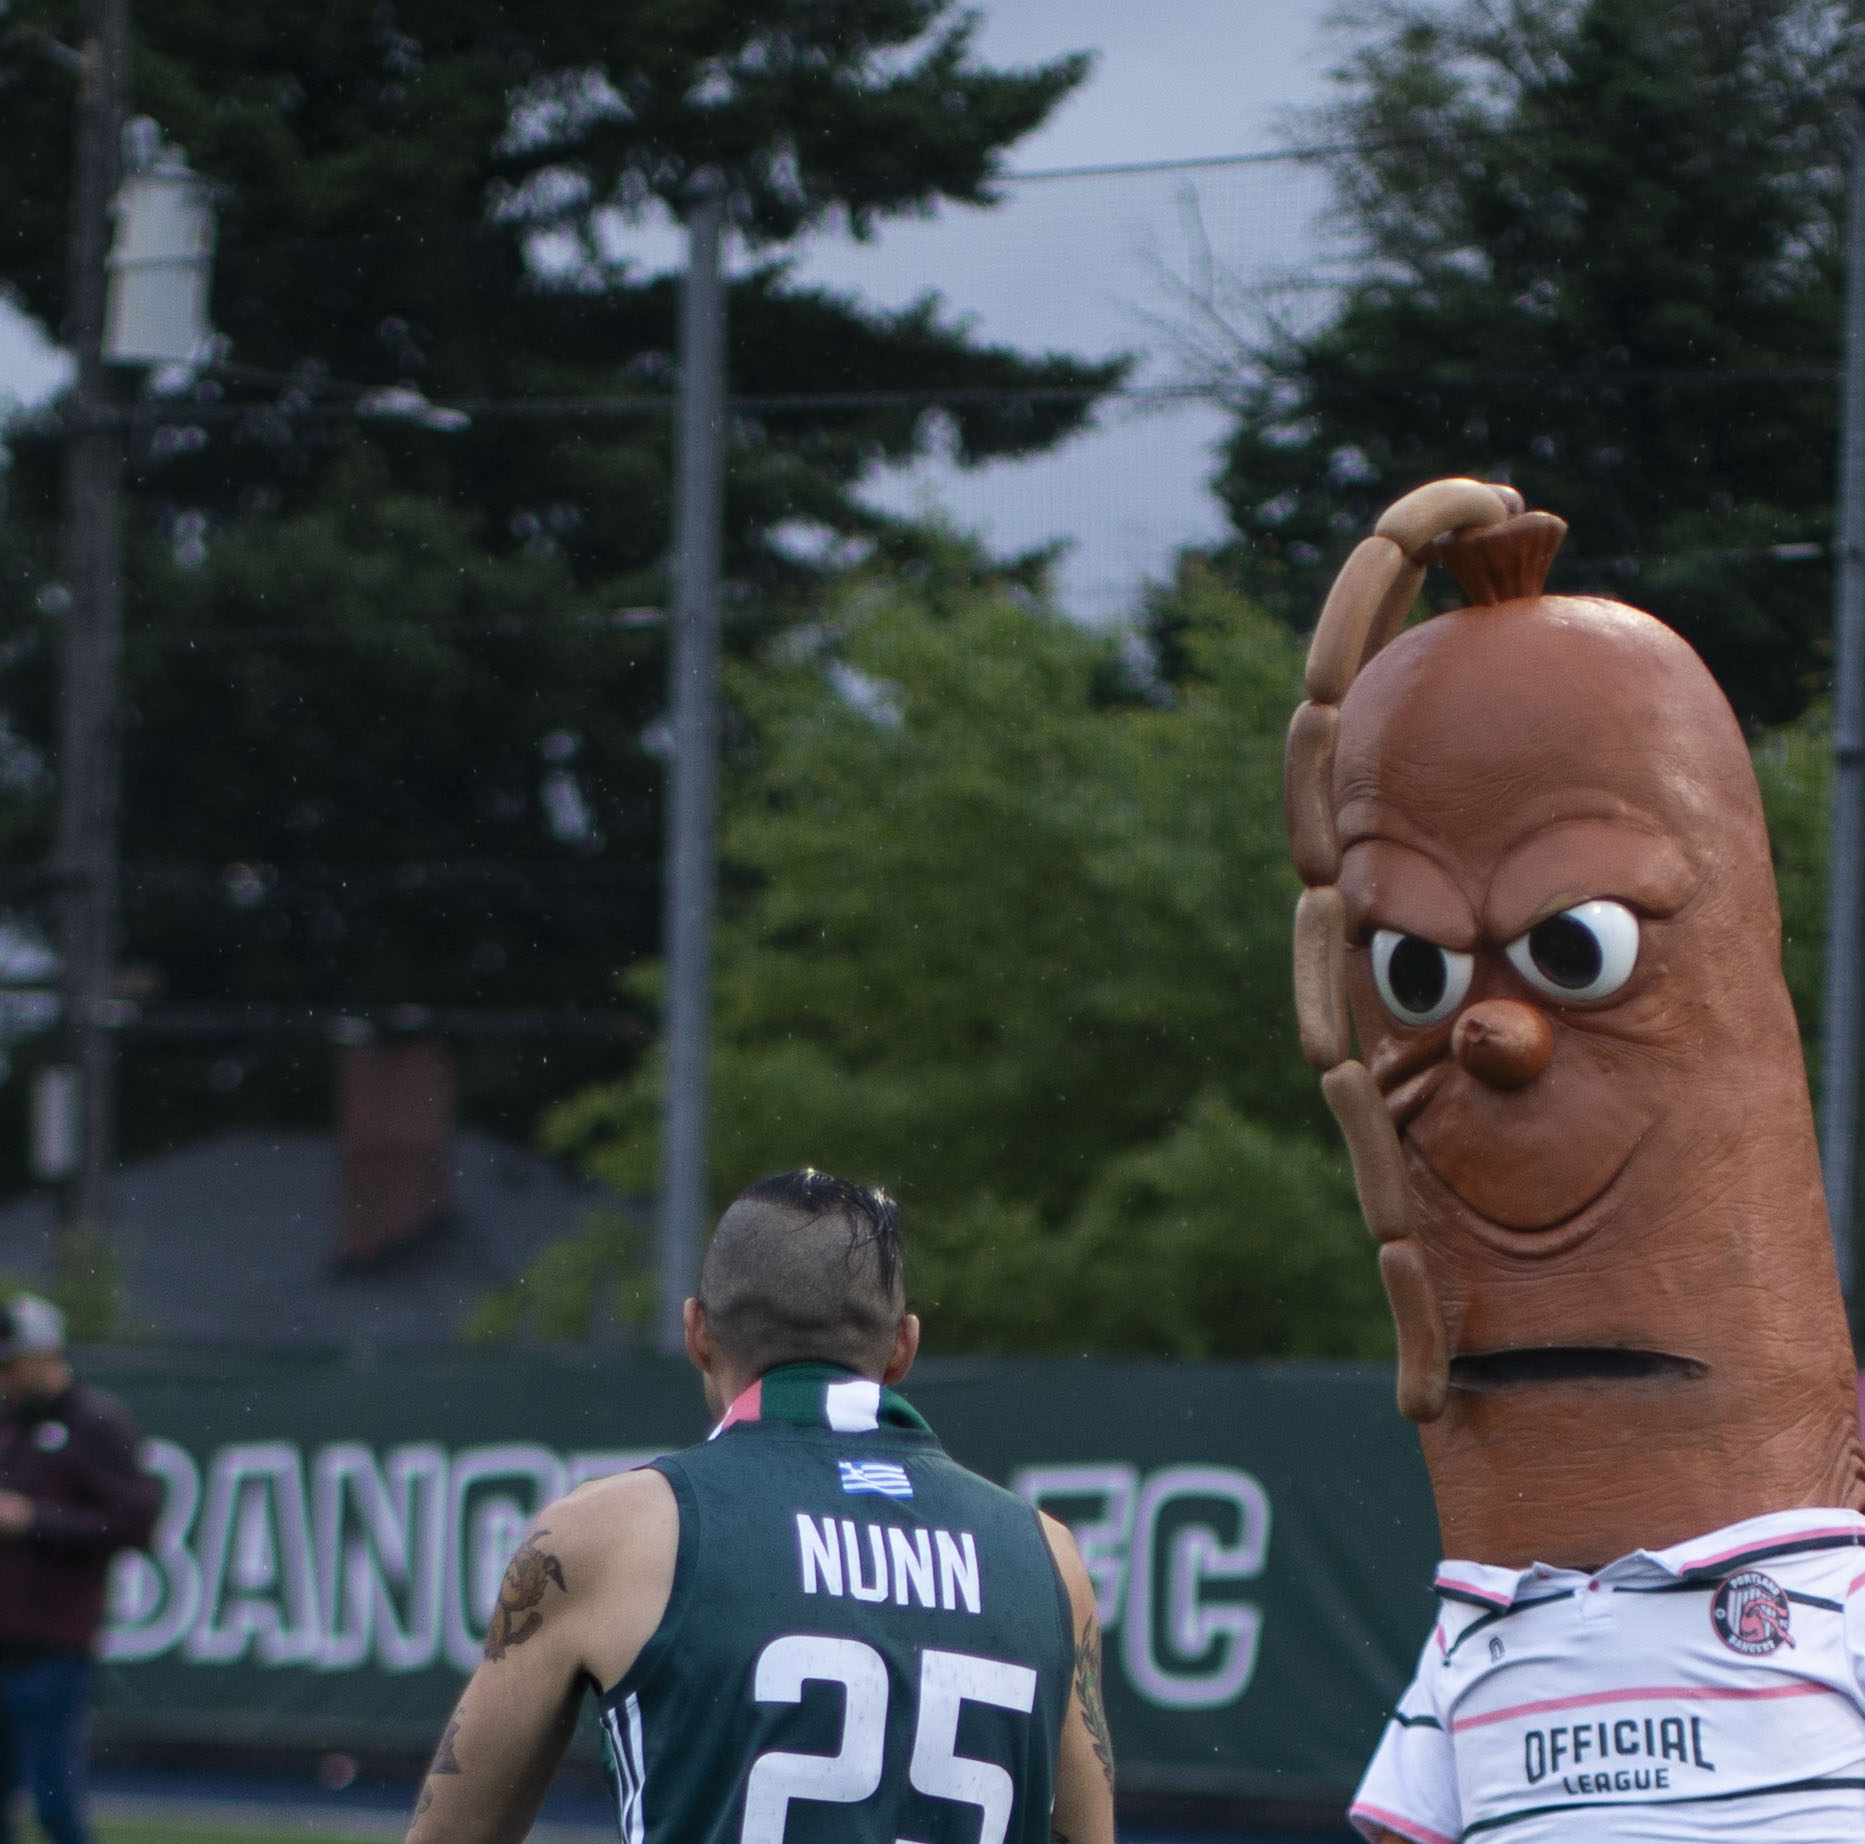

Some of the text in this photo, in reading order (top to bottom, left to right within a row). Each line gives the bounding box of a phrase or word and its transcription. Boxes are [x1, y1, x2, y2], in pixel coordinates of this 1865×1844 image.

[795, 1513, 982, 1613] NUNN
[1525, 1716, 1716, 1785] OFFICIAL
[1563, 1768, 1670, 1796] LEAGUE
